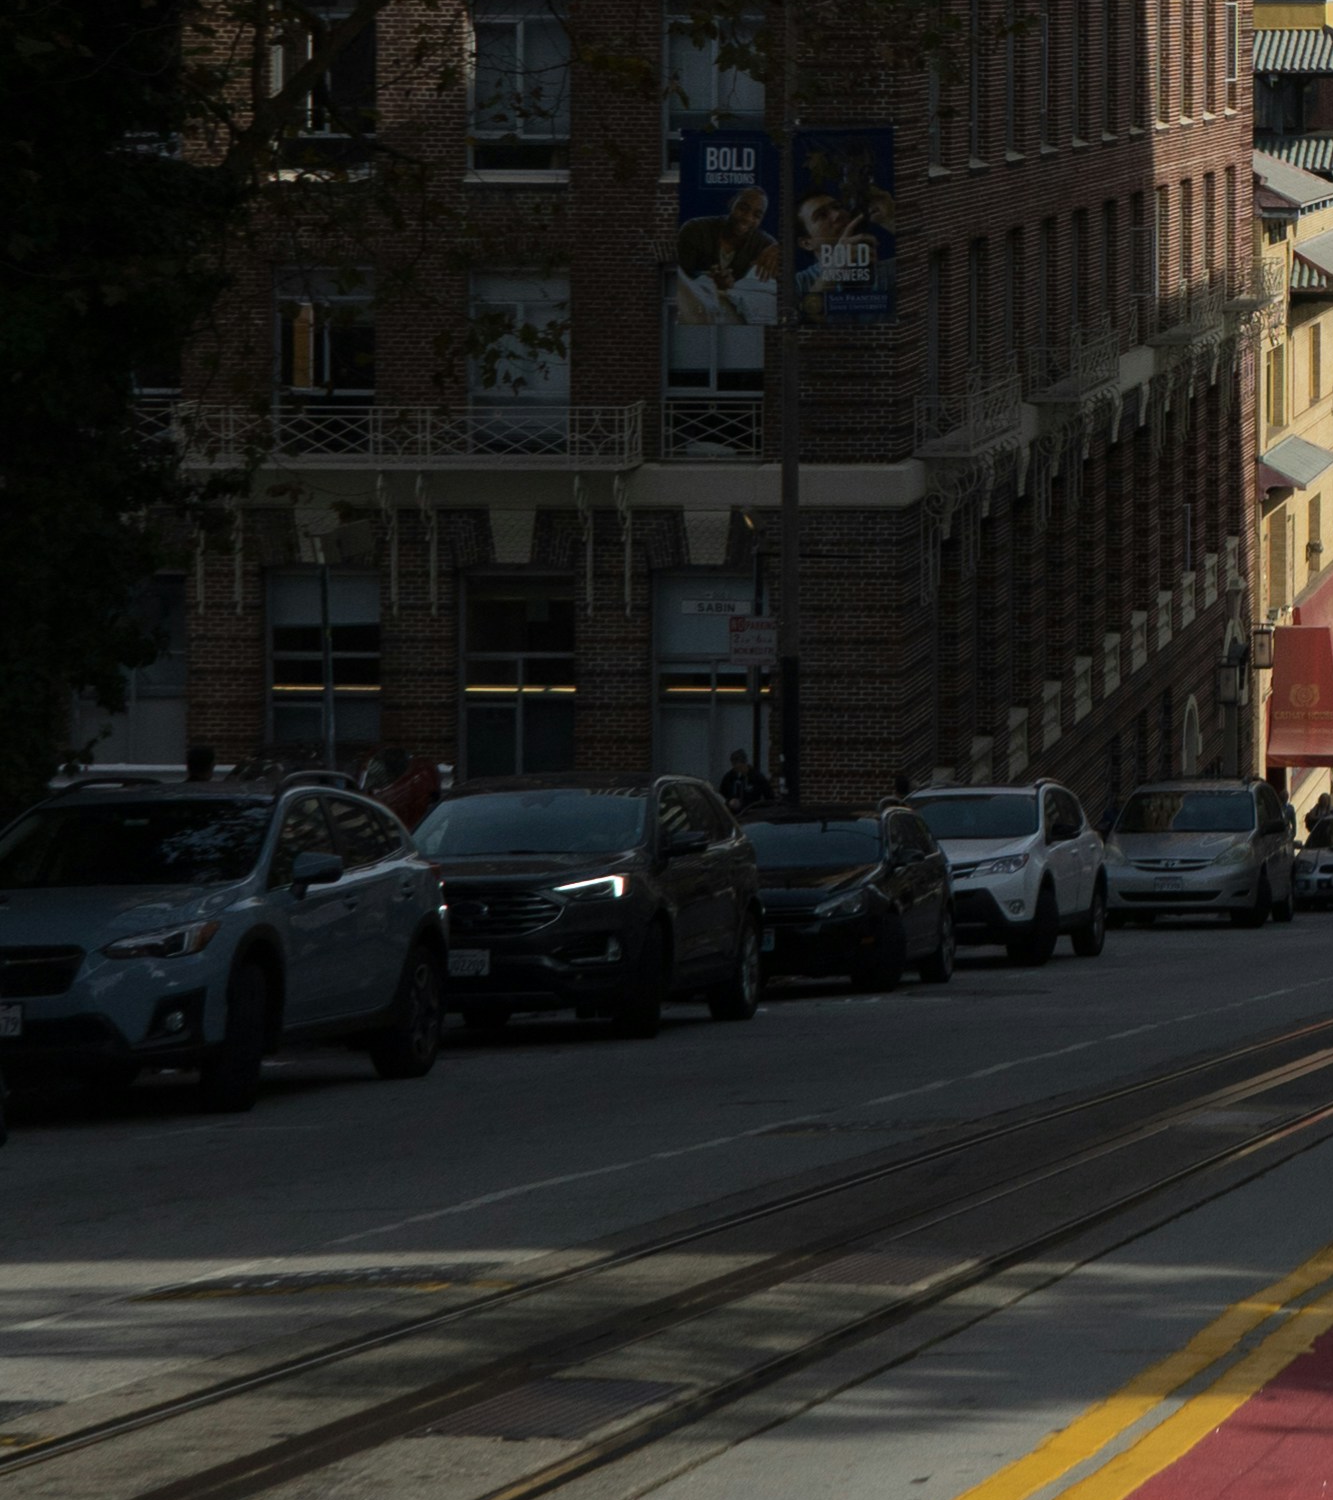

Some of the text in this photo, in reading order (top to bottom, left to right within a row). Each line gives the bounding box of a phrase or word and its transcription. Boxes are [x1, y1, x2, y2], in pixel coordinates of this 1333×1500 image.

[705, 146, 756, 171] BOLD
[705, 173, 756, 184] QUESTIONS
[820, 242, 871, 267] BOLD
[822, 268, 871, 282] ANSWERS
[697, 602, 736, 613] SABIN
[1273, 710, 1304, 721] CATHAY
